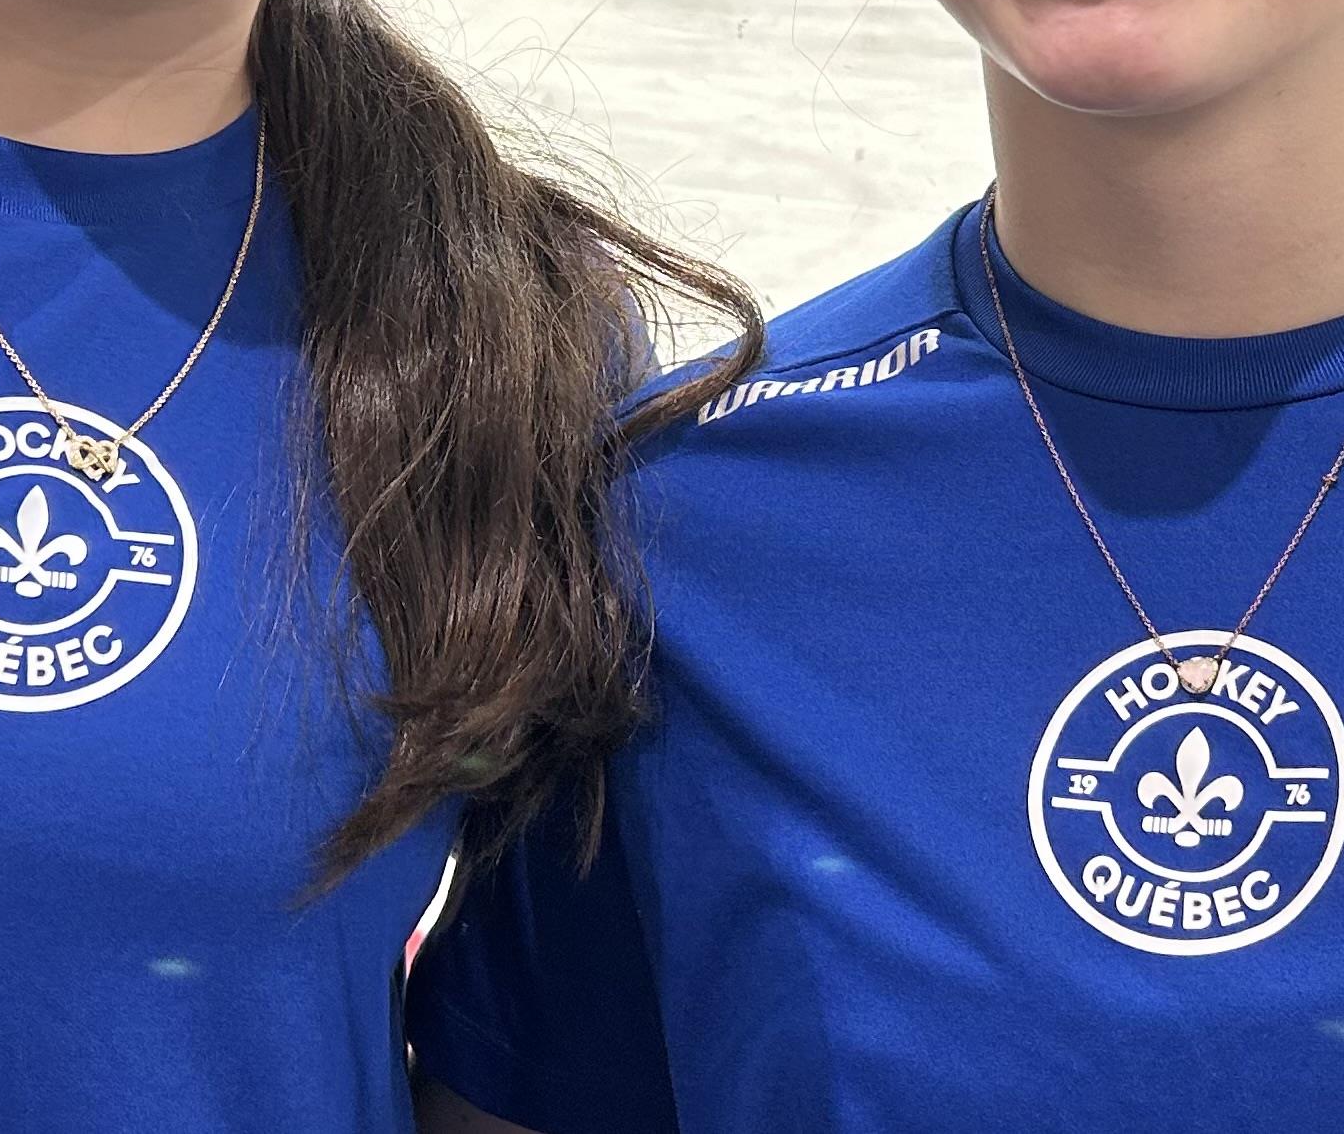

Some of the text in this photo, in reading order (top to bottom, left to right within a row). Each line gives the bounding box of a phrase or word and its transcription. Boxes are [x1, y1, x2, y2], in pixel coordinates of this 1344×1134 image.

[697, 327, 942, 427] WARRIOR
[128, 545, 157, 568] 76
[1104, 659, 1301, 726] HOKEY
[1068, 774, 1098, 795] 19
[1285, 784, 1311, 806] 76
[1082, 855, 1280, 931] QUÉBEC
